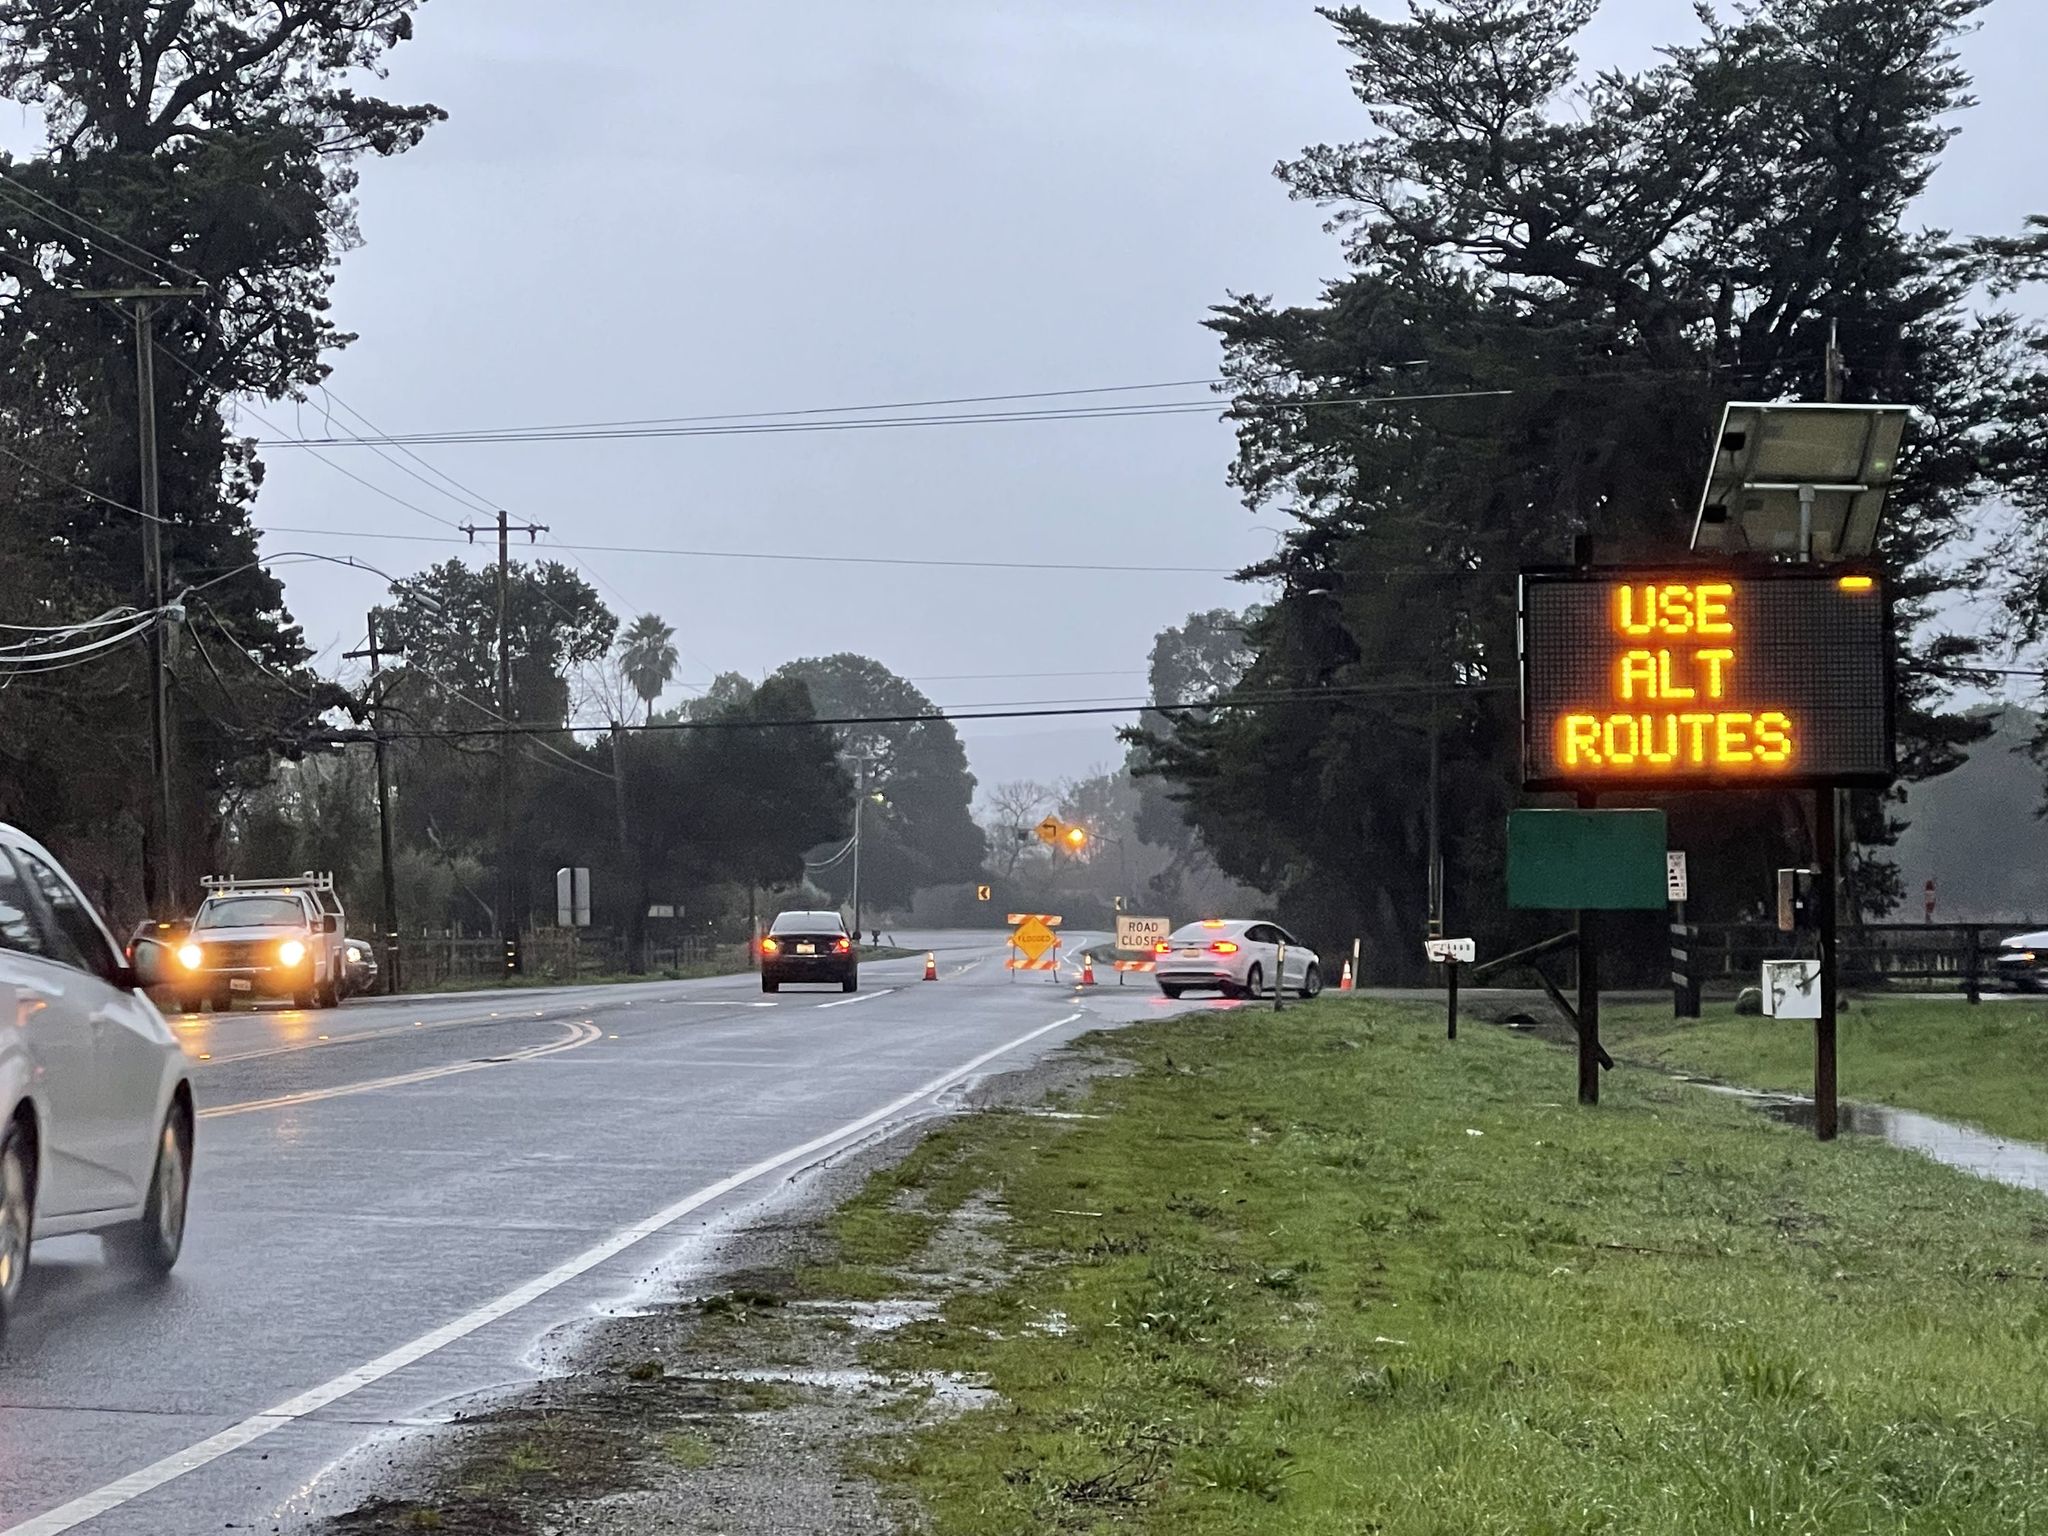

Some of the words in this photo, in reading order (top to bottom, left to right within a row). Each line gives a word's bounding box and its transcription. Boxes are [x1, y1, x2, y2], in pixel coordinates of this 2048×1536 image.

[1619, 584, 1734, 635] USE
[1620, 648, 1735, 699] ALT
[1564, 711, 1792, 764] ROUTES
[1128, 921, 1159, 932] ROAD
